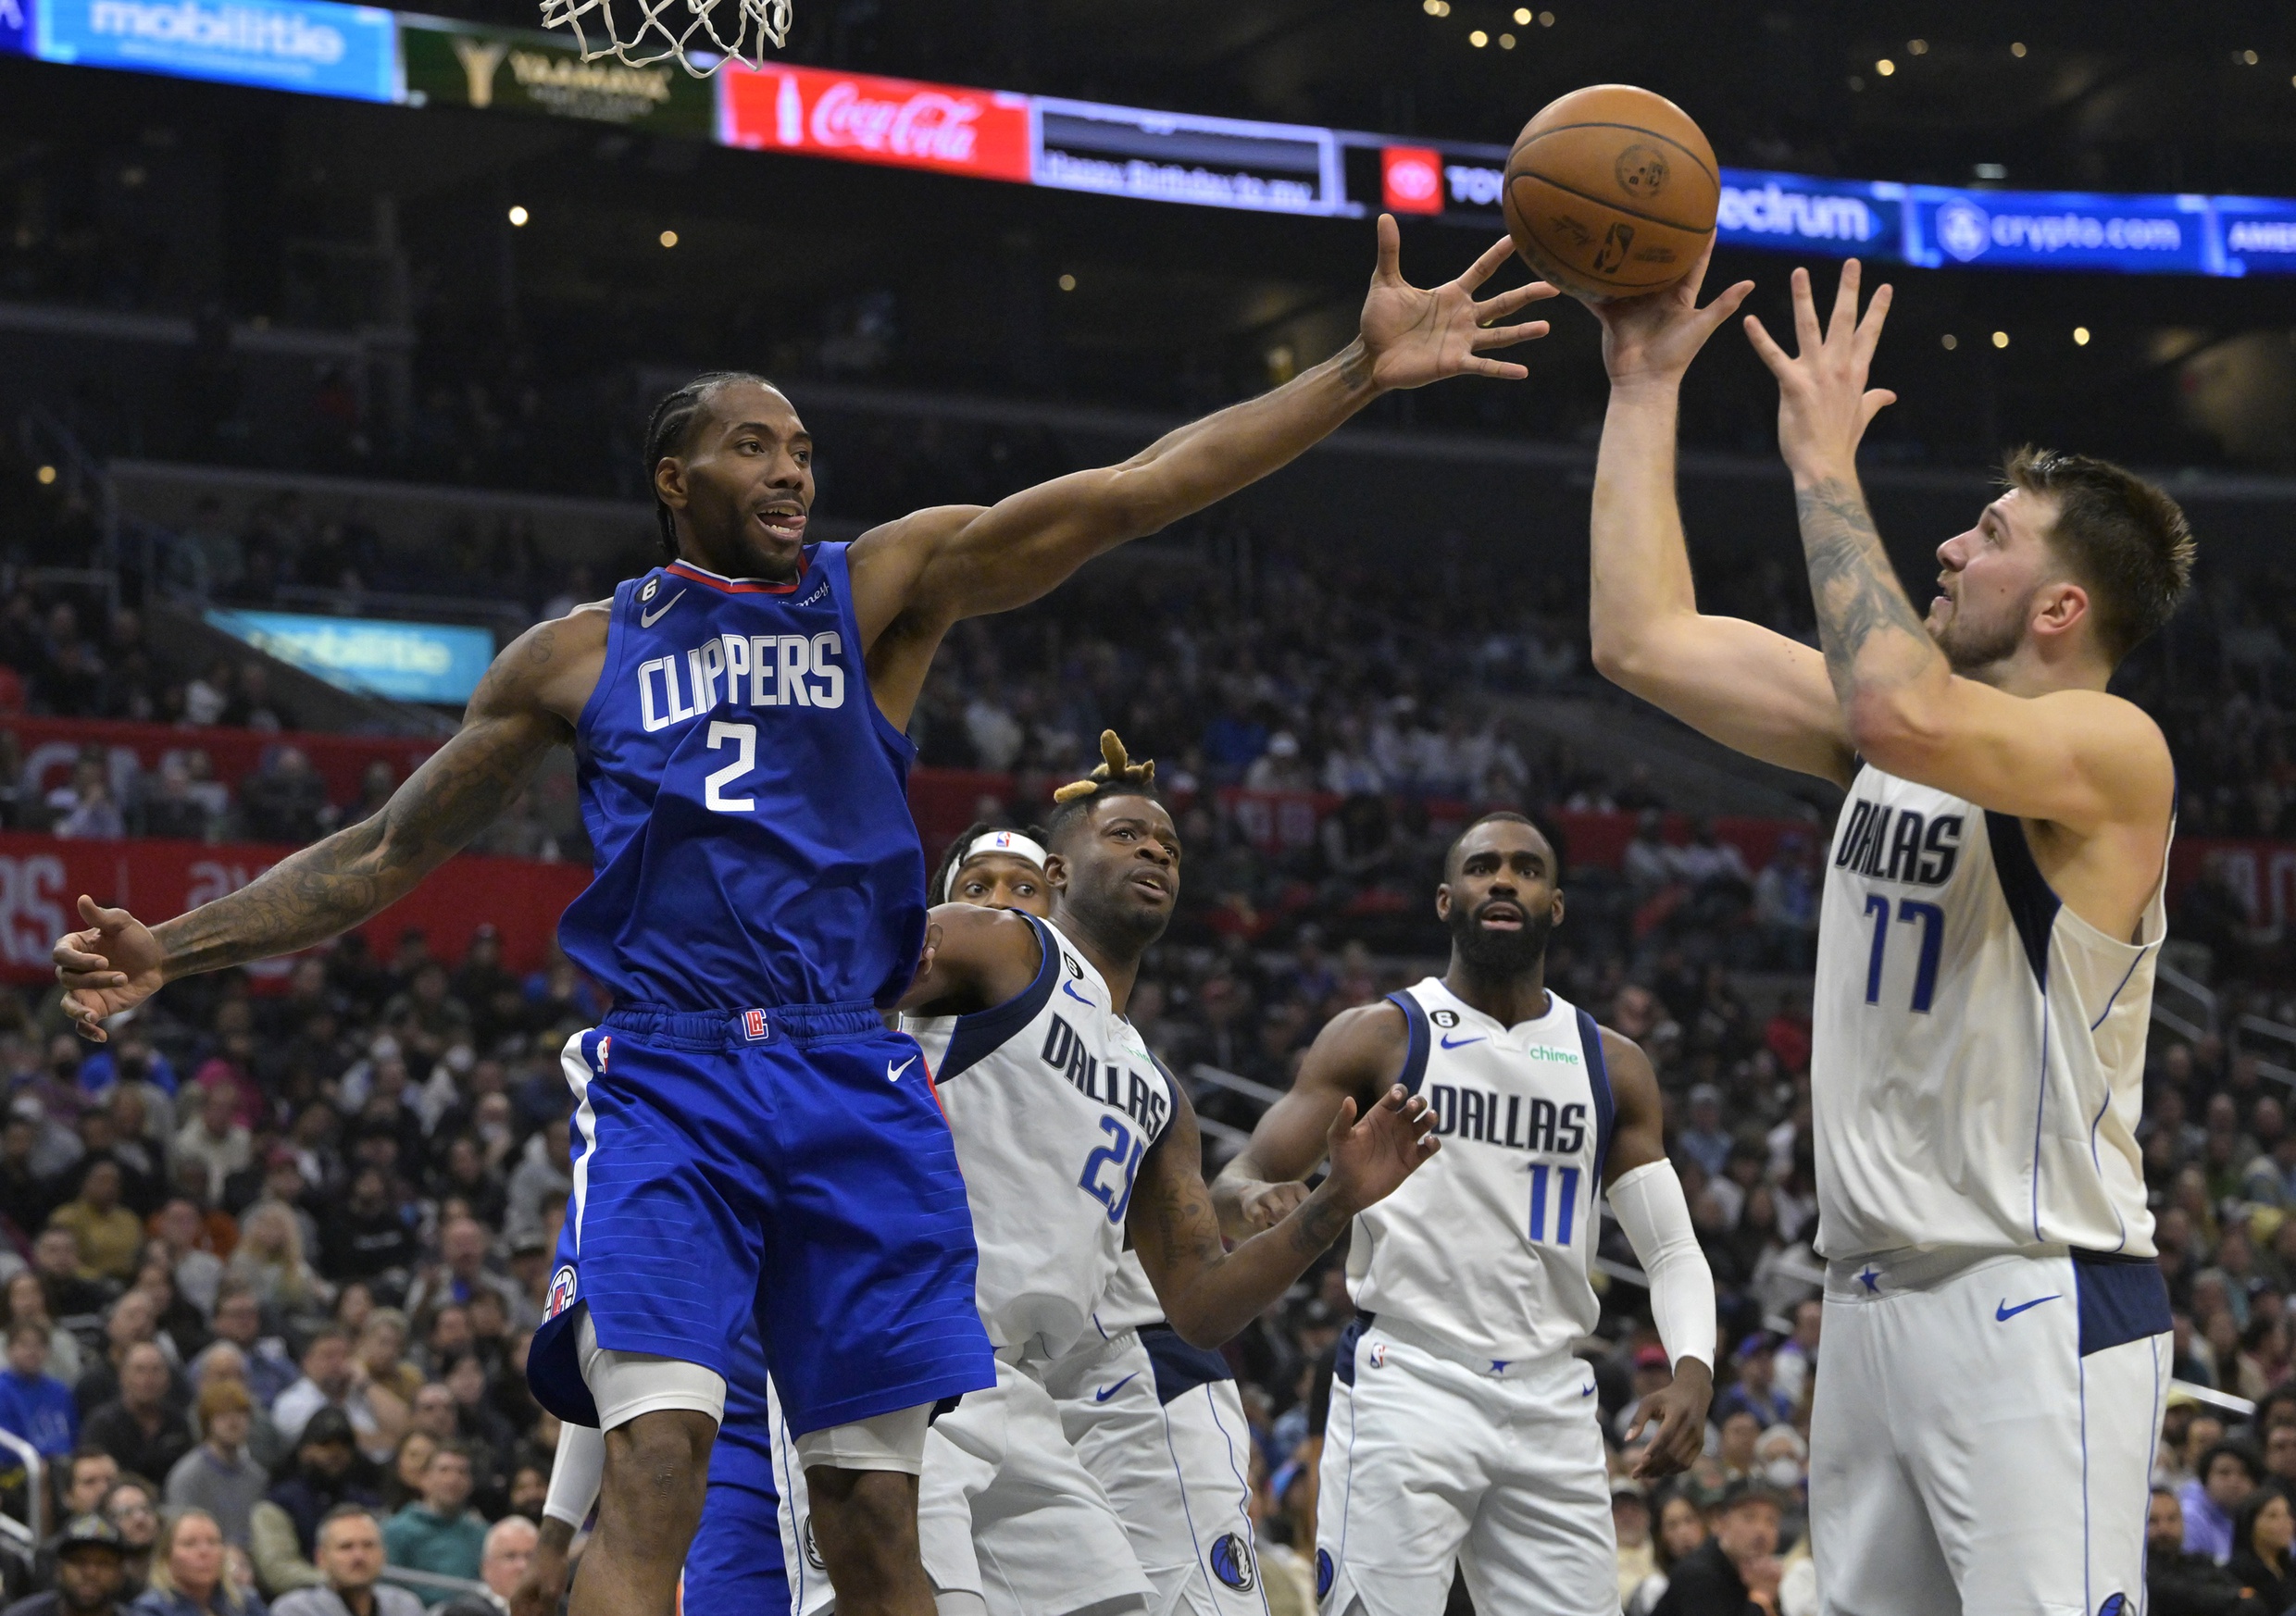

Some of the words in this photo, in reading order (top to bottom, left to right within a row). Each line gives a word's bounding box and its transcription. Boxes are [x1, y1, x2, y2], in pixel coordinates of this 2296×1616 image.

[642, 578, 657, 602] 6
[637, 630, 845, 732] CLIPPERS
[705, 720, 757, 812] 2
[1863, 891, 1945, 1015] 77
[1040, 1011, 1168, 1145] DALLAS
[1529, 1044, 1579, 1066] chime
[1430, 1083, 1587, 1155] DALLAS
[1527, 1162, 1580, 1247] 11
